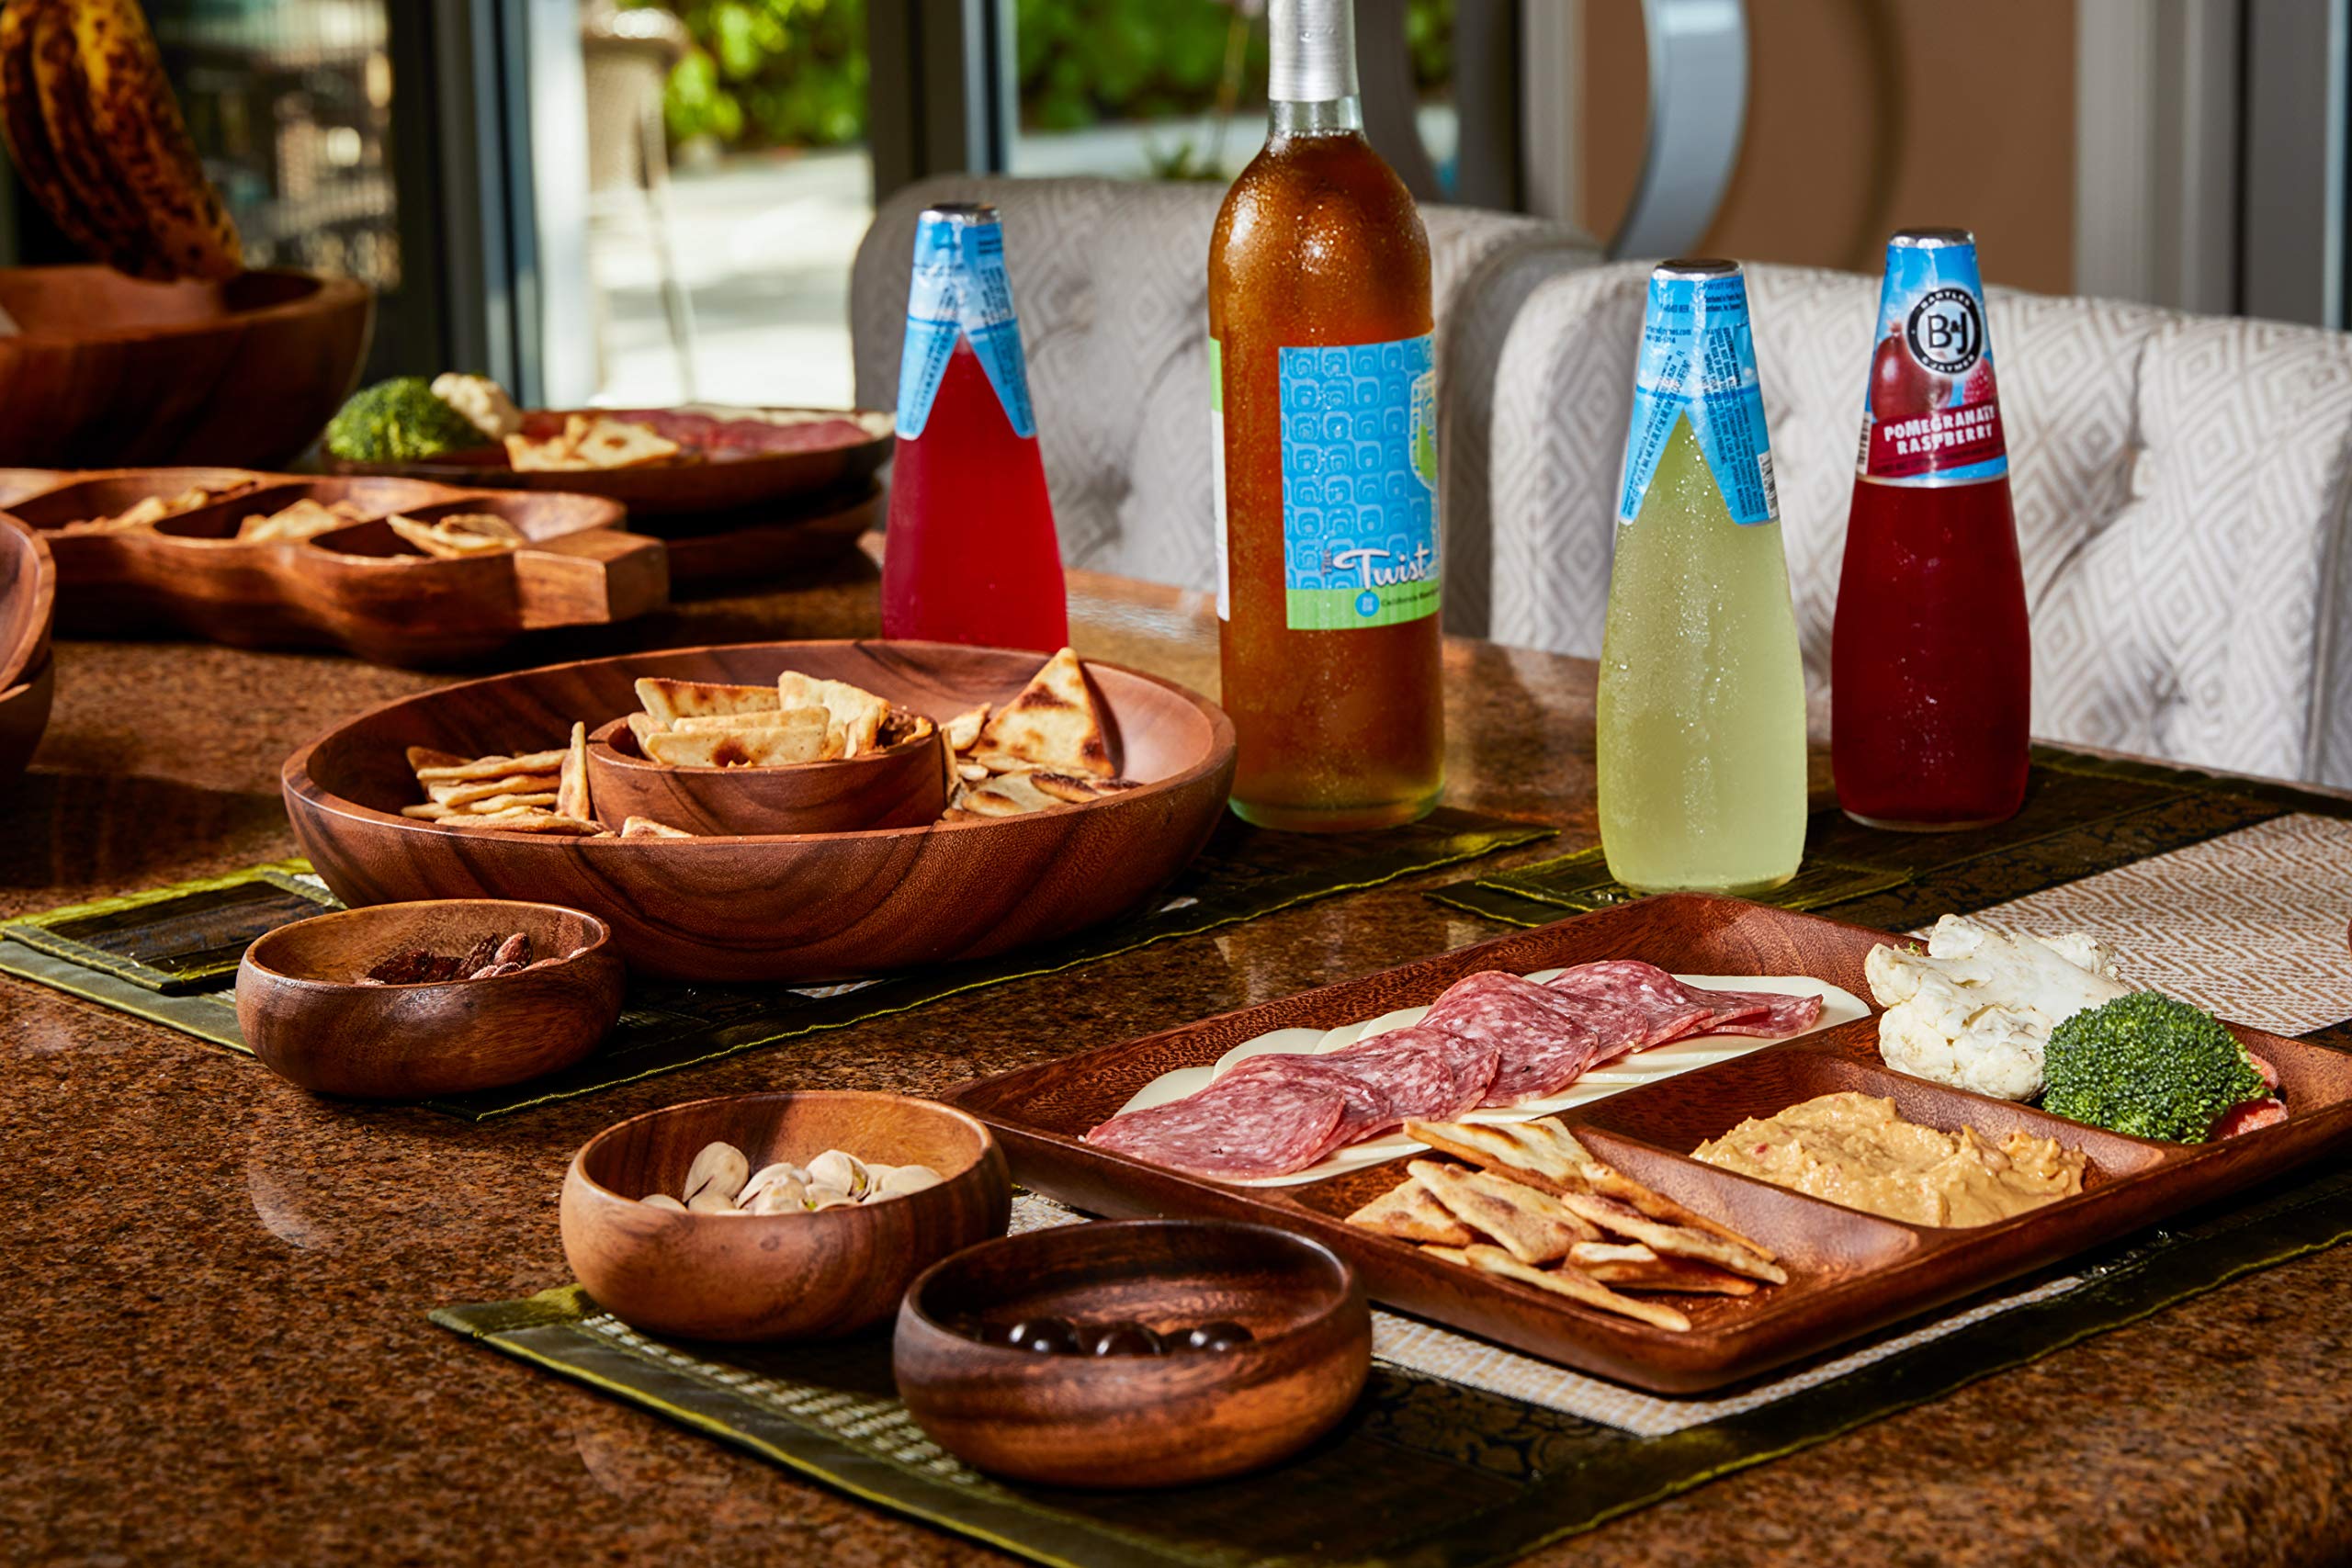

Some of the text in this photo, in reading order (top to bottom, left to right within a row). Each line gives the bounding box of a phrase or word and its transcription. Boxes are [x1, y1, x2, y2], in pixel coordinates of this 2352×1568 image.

[1883, 404, 1996, 442] POMEGRANATE
[1895, 423, 1993, 456] RASPBERRY
[1332, 541, 1430, 592] Twist
